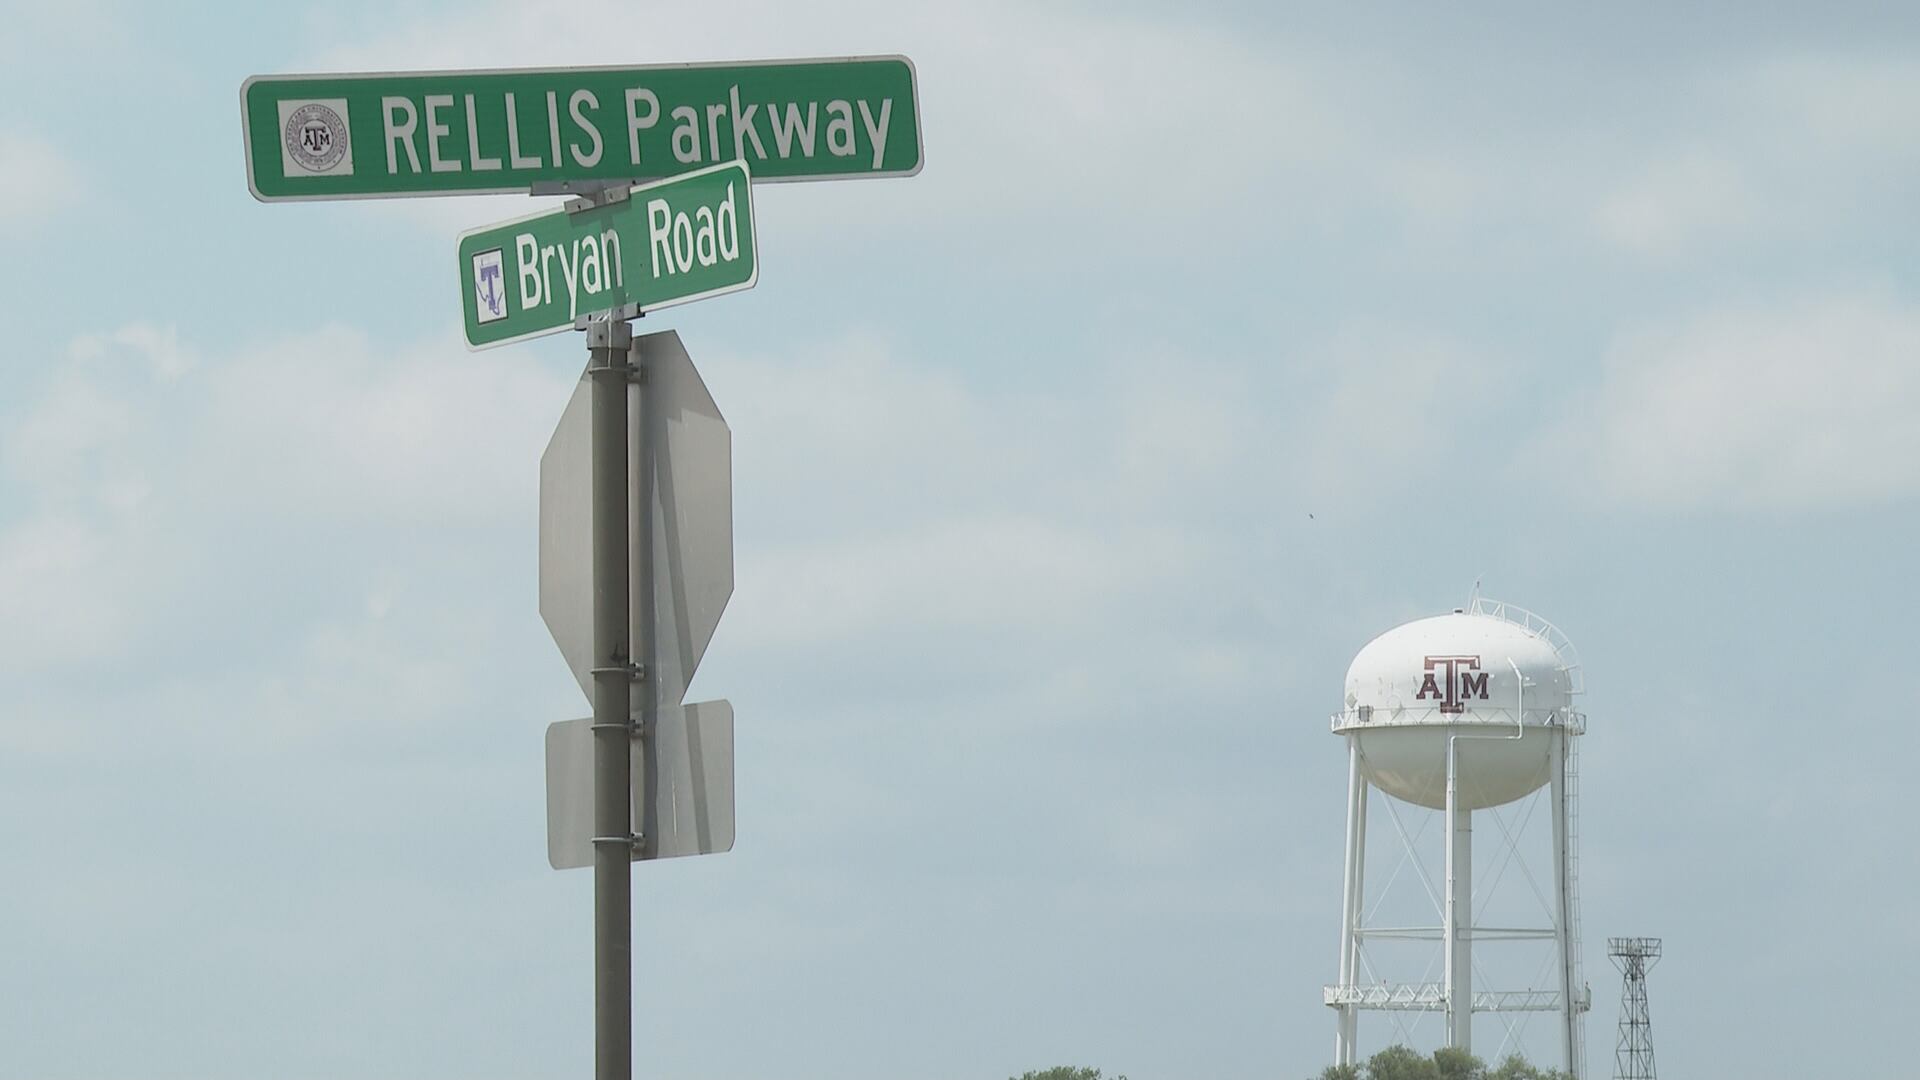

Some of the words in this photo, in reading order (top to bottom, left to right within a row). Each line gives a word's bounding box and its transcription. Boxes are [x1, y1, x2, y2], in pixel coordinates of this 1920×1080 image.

[381, 89, 604, 174] RELLIS
[625, 84, 893, 169] Parkway
[515, 229, 624, 321] Bryan
[647, 180, 740, 279] Road
[1416, 655, 1489, 713] ATM
